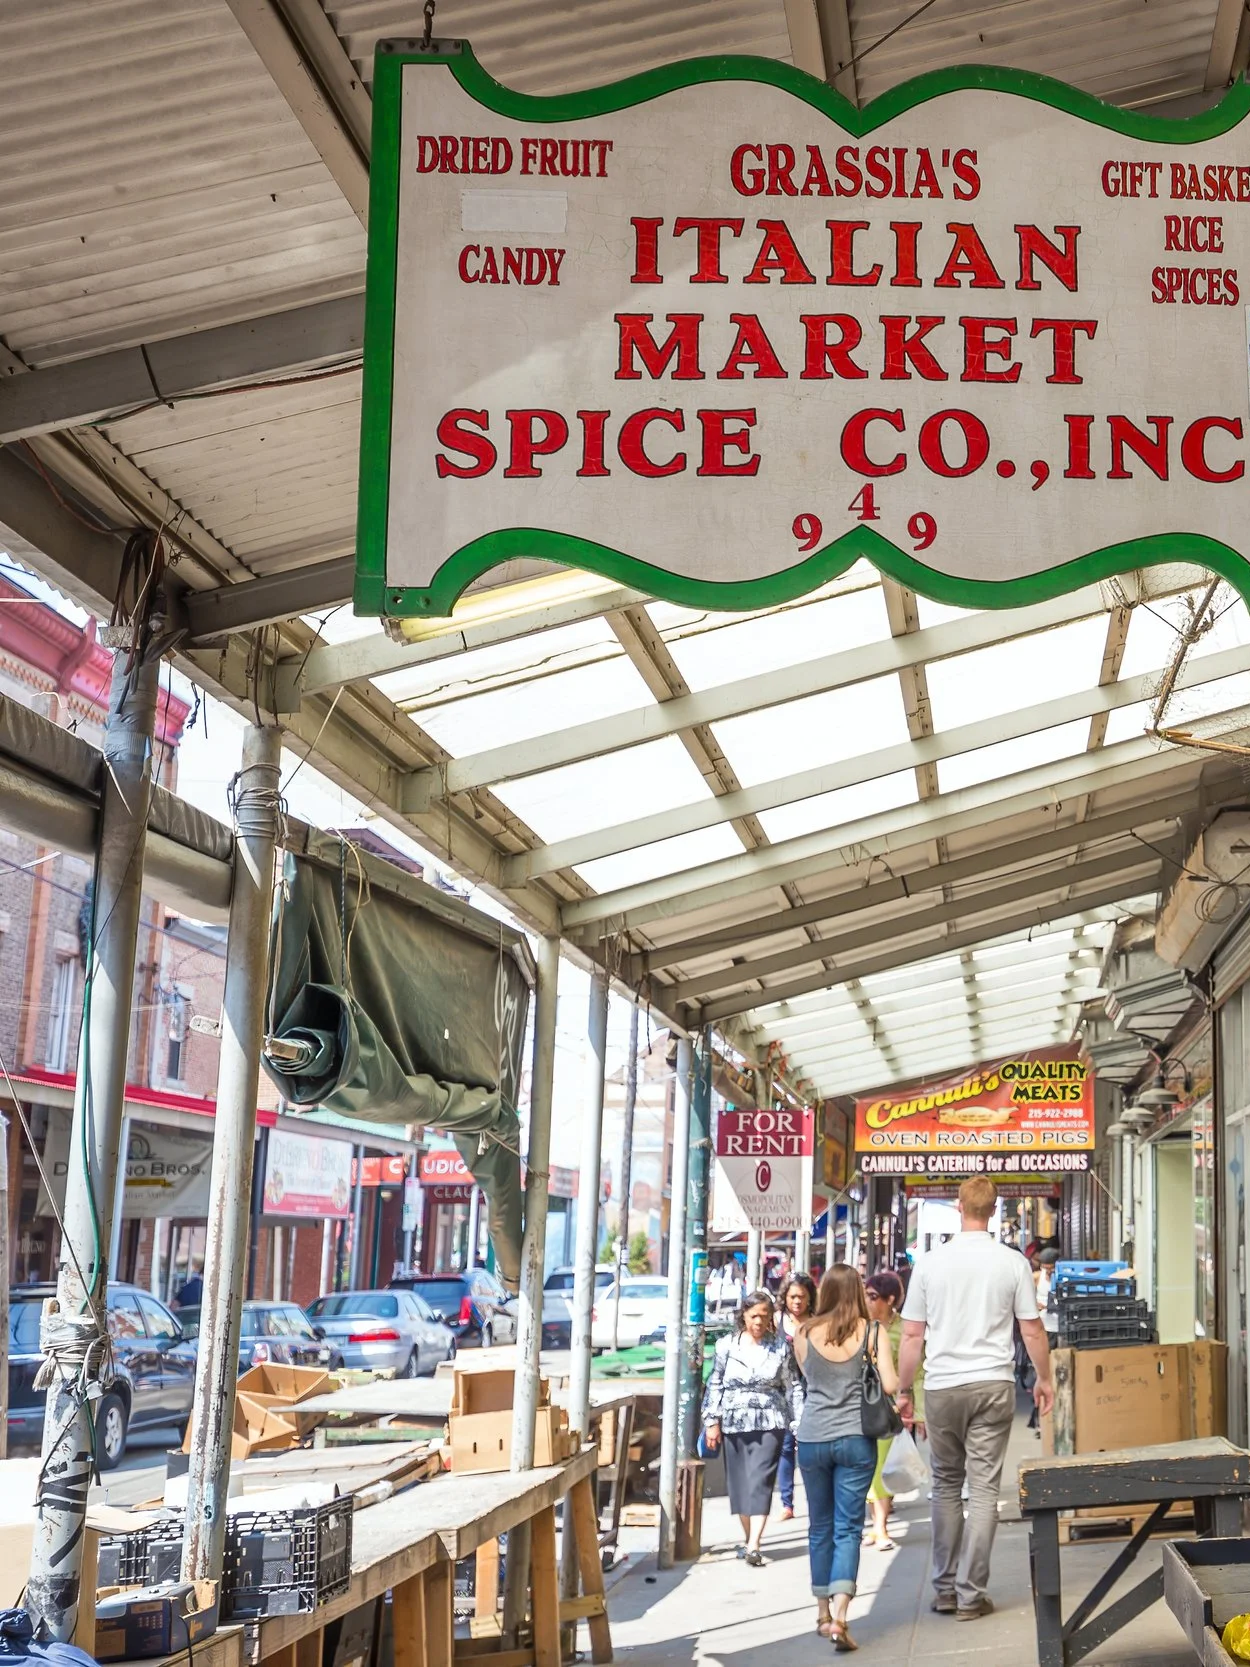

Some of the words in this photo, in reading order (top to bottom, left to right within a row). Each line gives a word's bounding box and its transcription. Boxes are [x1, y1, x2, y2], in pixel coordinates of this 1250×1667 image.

[416, 135, 513, 175] DRIED
[519, 137, 614, 178] FRUIT
[730, 143, 981, 202] GRASSIA'S
[1100, 160, 1163, 199] GIFT
[630, 216, 1081, 292] ITALIAN
[1164, 214, 1224, 254] RICE
[458, 244, 567, 287] CANDY
[1151, 266, 1240, 306] SPICES
[614, 313, 1098, 386] MARKET
[435, 407, 761, 479] SPICE
[865, 1075, 1001, 1129] Cannuli's
[1000, 1061, 1088, 1081] QUALITY
[1011, 1083, 1082, 1102] MEATS
[736, 1112, 797, 1133] FOR
[871, 1132, 928, 1145] OVEN
[938, 1132, 1034, 1145] ROASTED
[1042, 1131, 1088, 1144] PIGS
[724, 1134, 807, 1155] RENT
[861, 1155, 926, 1172] CANNULI'S
[928, 1155, 985, 1172] CATERING
[986, 1154, 1004, 1171] for
[1005, 1154, 1019, 1171] all
[1020, 1154, 1089, 1171] OCCASIONS
[736, 1194, 794, 1205] OSMOPOLITAN
[740, 1205, 792, 1214] ANAGEMENT
